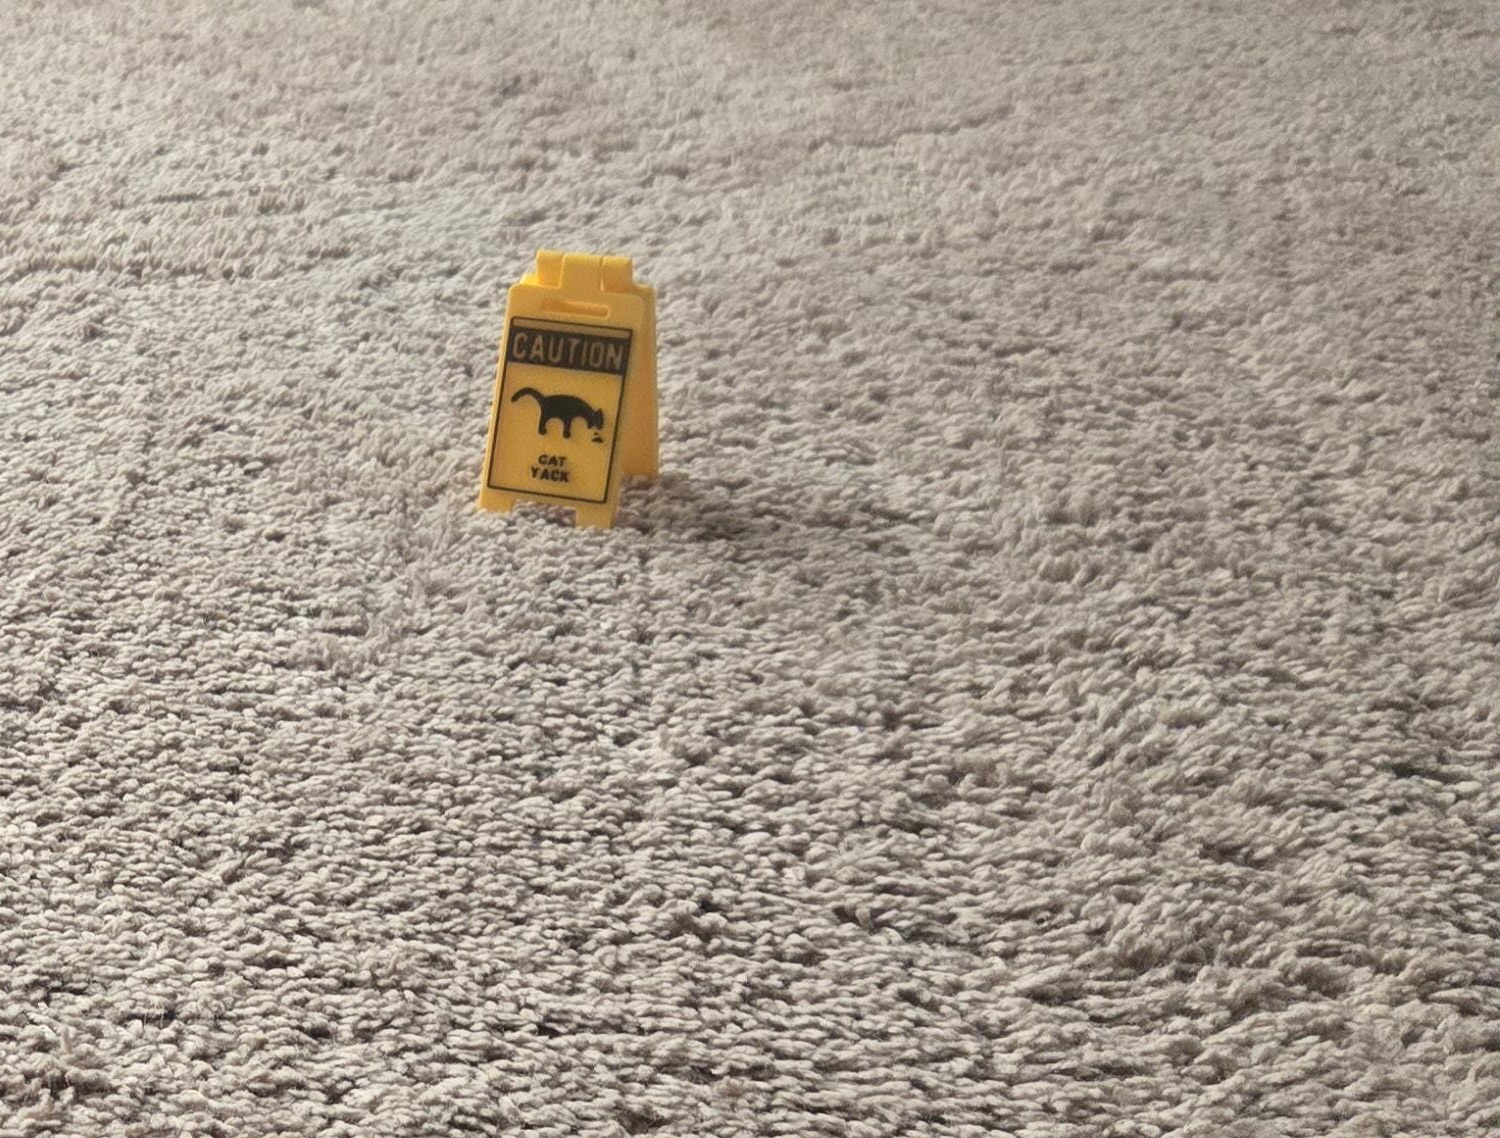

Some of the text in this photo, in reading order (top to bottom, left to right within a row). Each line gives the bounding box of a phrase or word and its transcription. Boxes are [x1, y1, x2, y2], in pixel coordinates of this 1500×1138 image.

[513, 333, 623, 370] CAUTION
[538, 454, 567, 467] CAT
[531, 467, 569, 482] YACK
